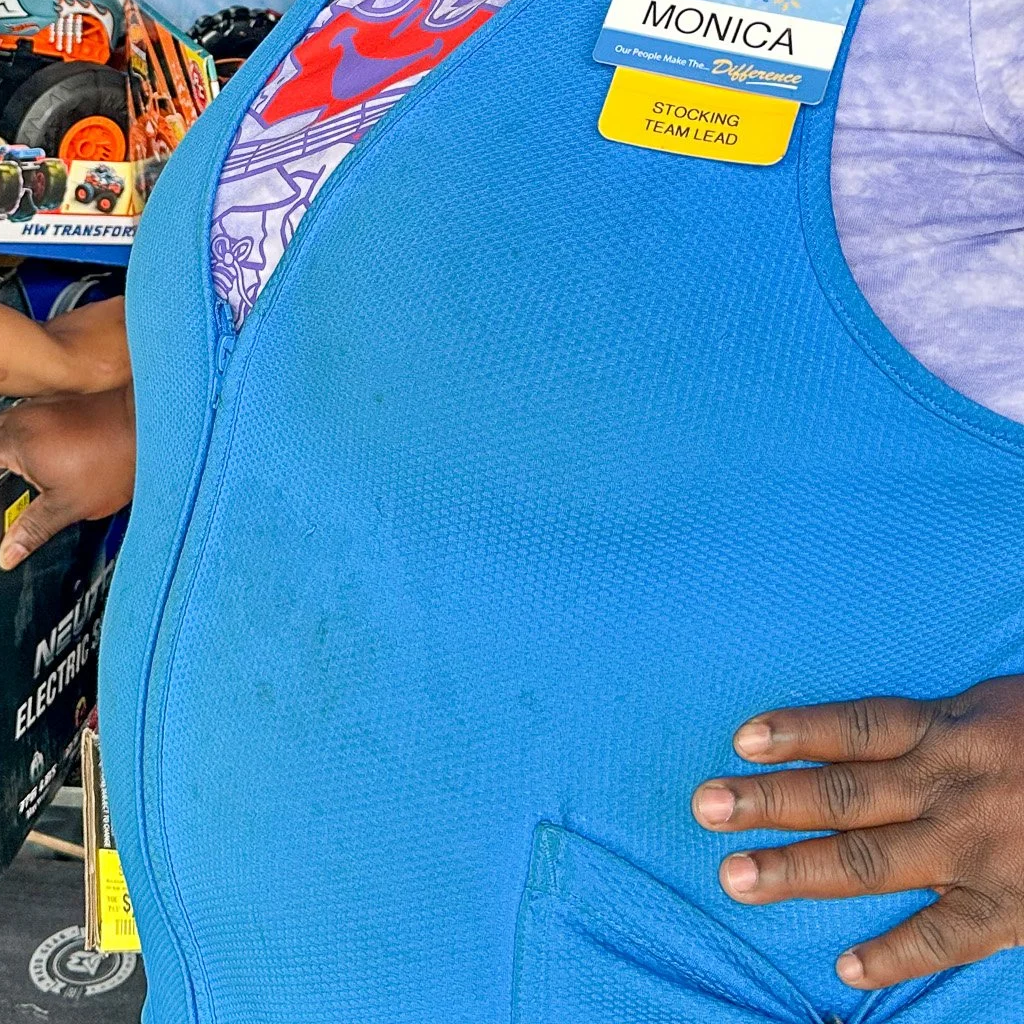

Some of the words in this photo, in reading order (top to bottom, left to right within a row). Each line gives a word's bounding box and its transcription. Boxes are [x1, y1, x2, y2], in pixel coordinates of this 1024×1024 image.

[642, 0, 794, 56] MONICA
[615, 44, 632, 55] Our
[633, 47, 661, 63] People
[663, 54, 687, 67] Make
[711, 58, 802, 84] Difference
[653, 101, 740, 127] STOCKING
[644, 118, 690, 139] TEAM
[693, 125, 738, 146] LEAD
[22, 223, 48, 236] HW
[14, 632, 90, 742] ELECTRIC
